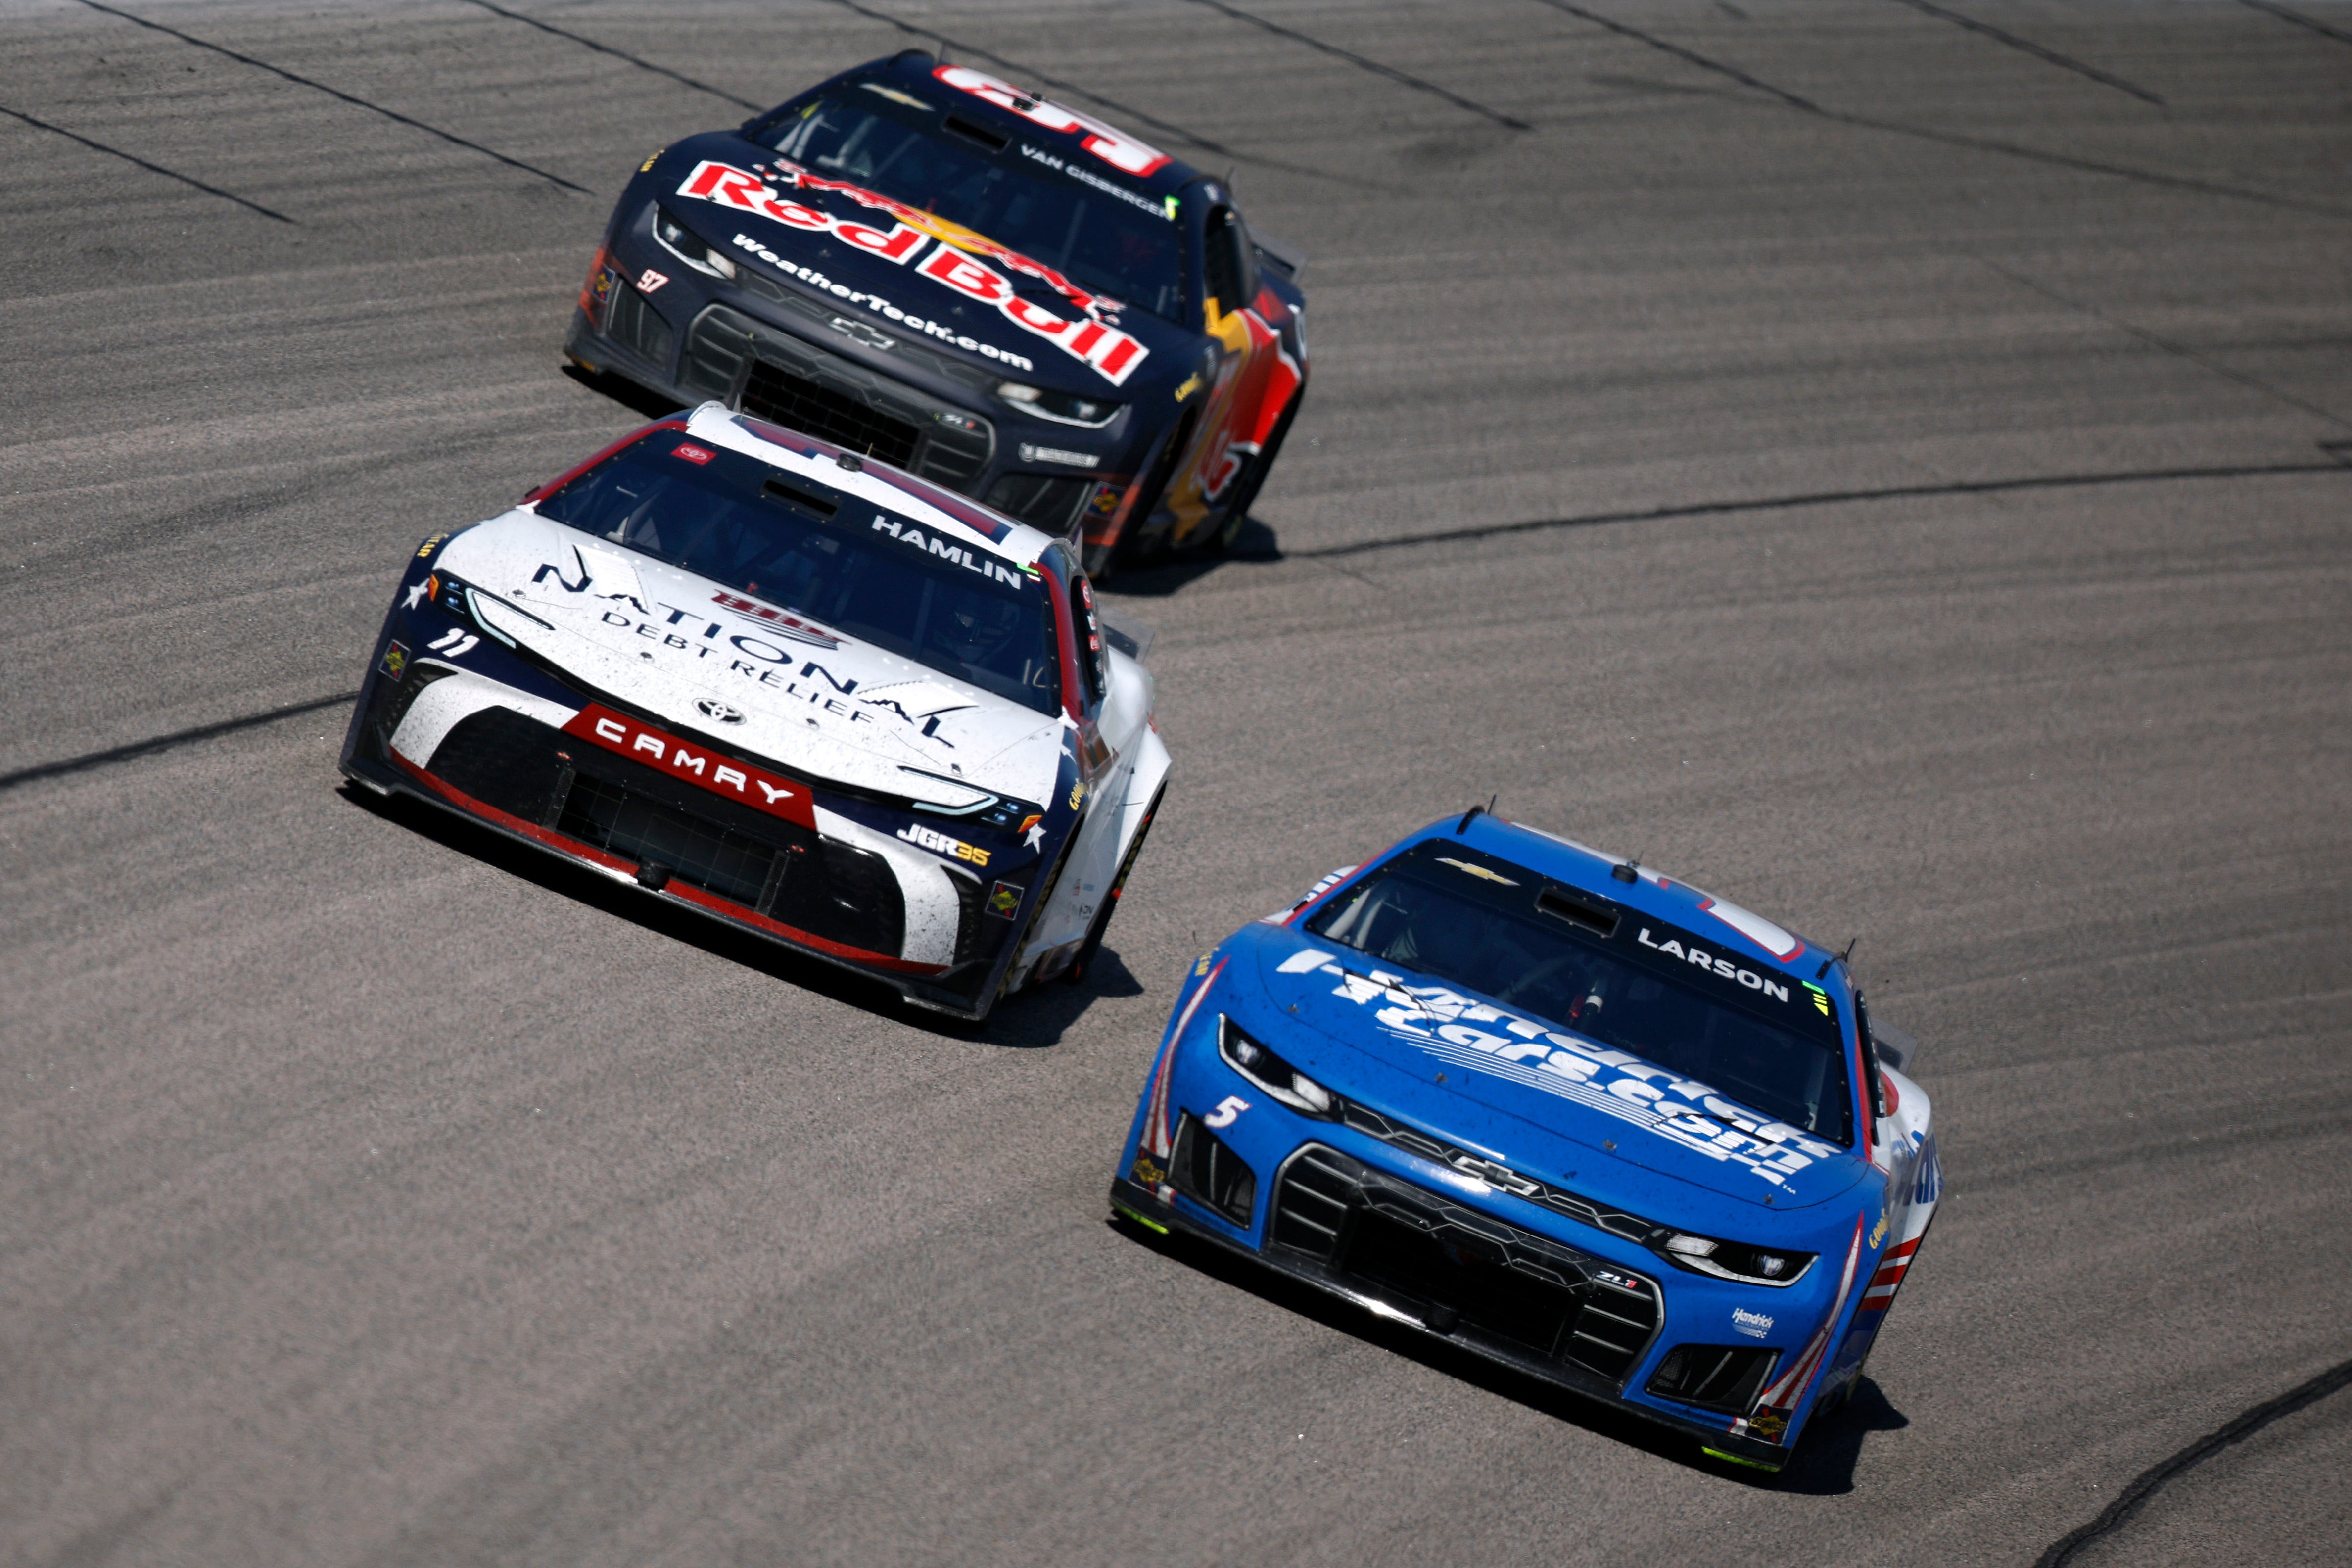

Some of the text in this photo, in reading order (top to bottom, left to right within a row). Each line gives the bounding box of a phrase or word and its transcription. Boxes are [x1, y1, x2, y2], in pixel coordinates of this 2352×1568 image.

[1020, 143, 1063, 171] VAN
[636, 268, 670, 293] 97
[676, 159, 1150, 388] Red Bull
[871, 514, 1022, 590] HAMLIN
[427, 627, 480, 658] 11
[601, 612, 875, 724] DEBT RELIEF
[595, 717, 794, 804] CAMRY
[896, 823, 992, 867] JGR35
[1637, 928, 1789, 1003] LARSON
[1203, 1095, 1252, 1128] 5
[1596, 1270, 1637, 1289] ZL1
[1732, 1307, 1775, 1329] Hendrick
